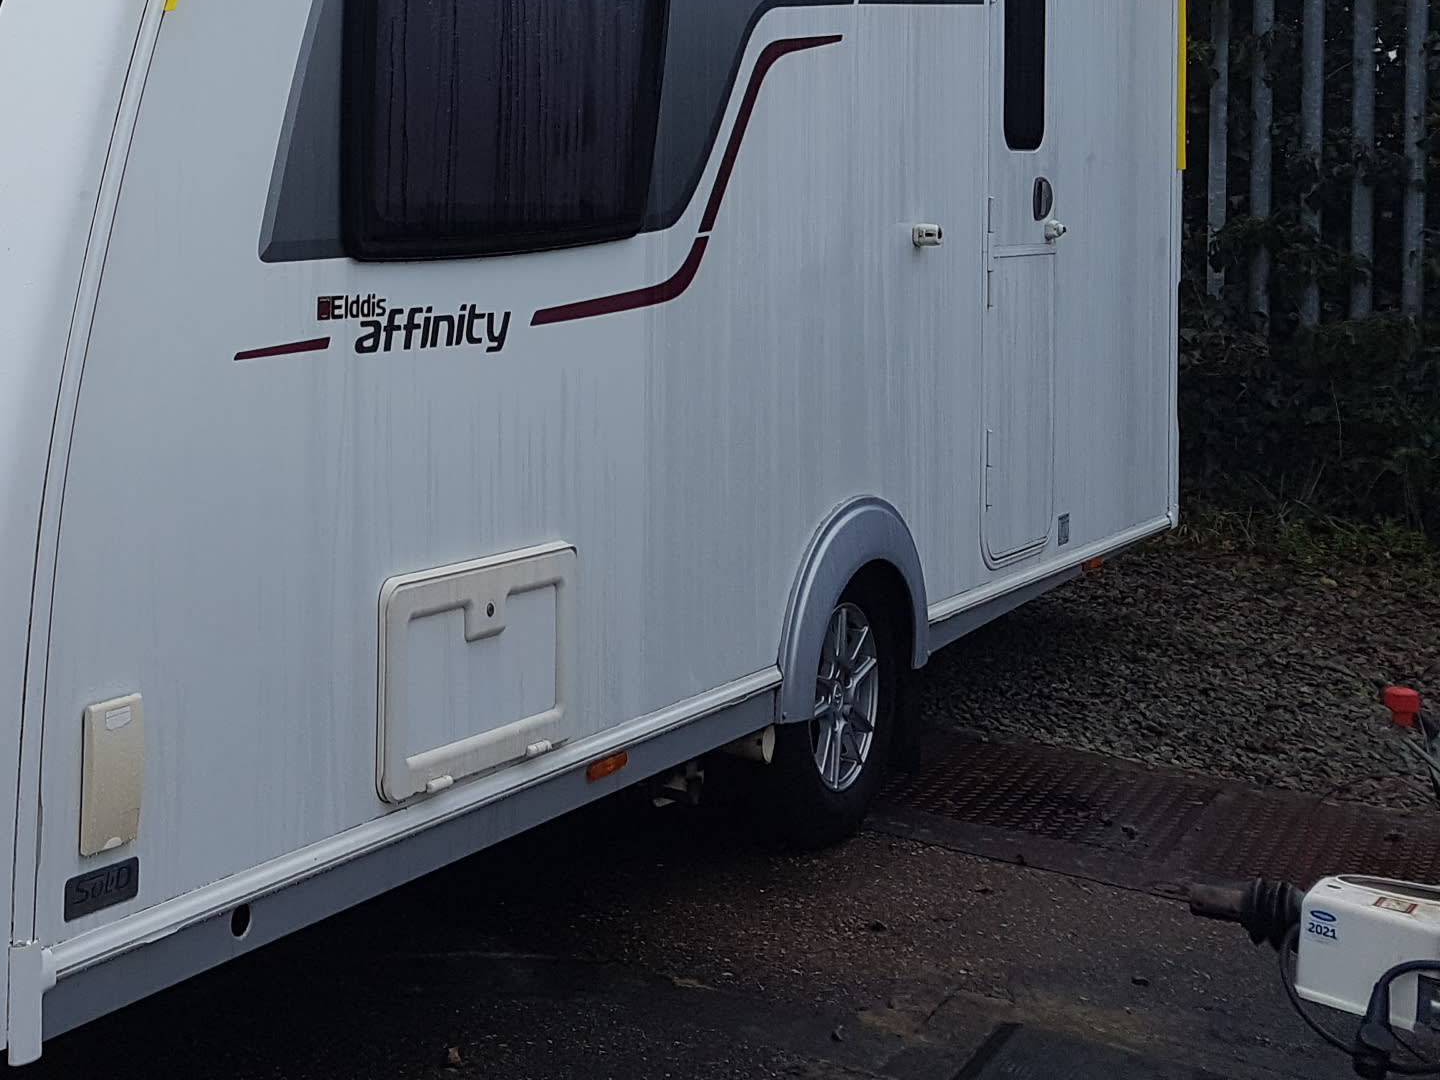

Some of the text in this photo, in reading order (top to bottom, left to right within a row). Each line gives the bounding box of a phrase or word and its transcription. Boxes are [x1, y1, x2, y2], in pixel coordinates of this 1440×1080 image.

[330, 293, 387, 320] Elddis
[354, 303, 512, 355] affinity
[1307, 921, 1338, 941] 2021
